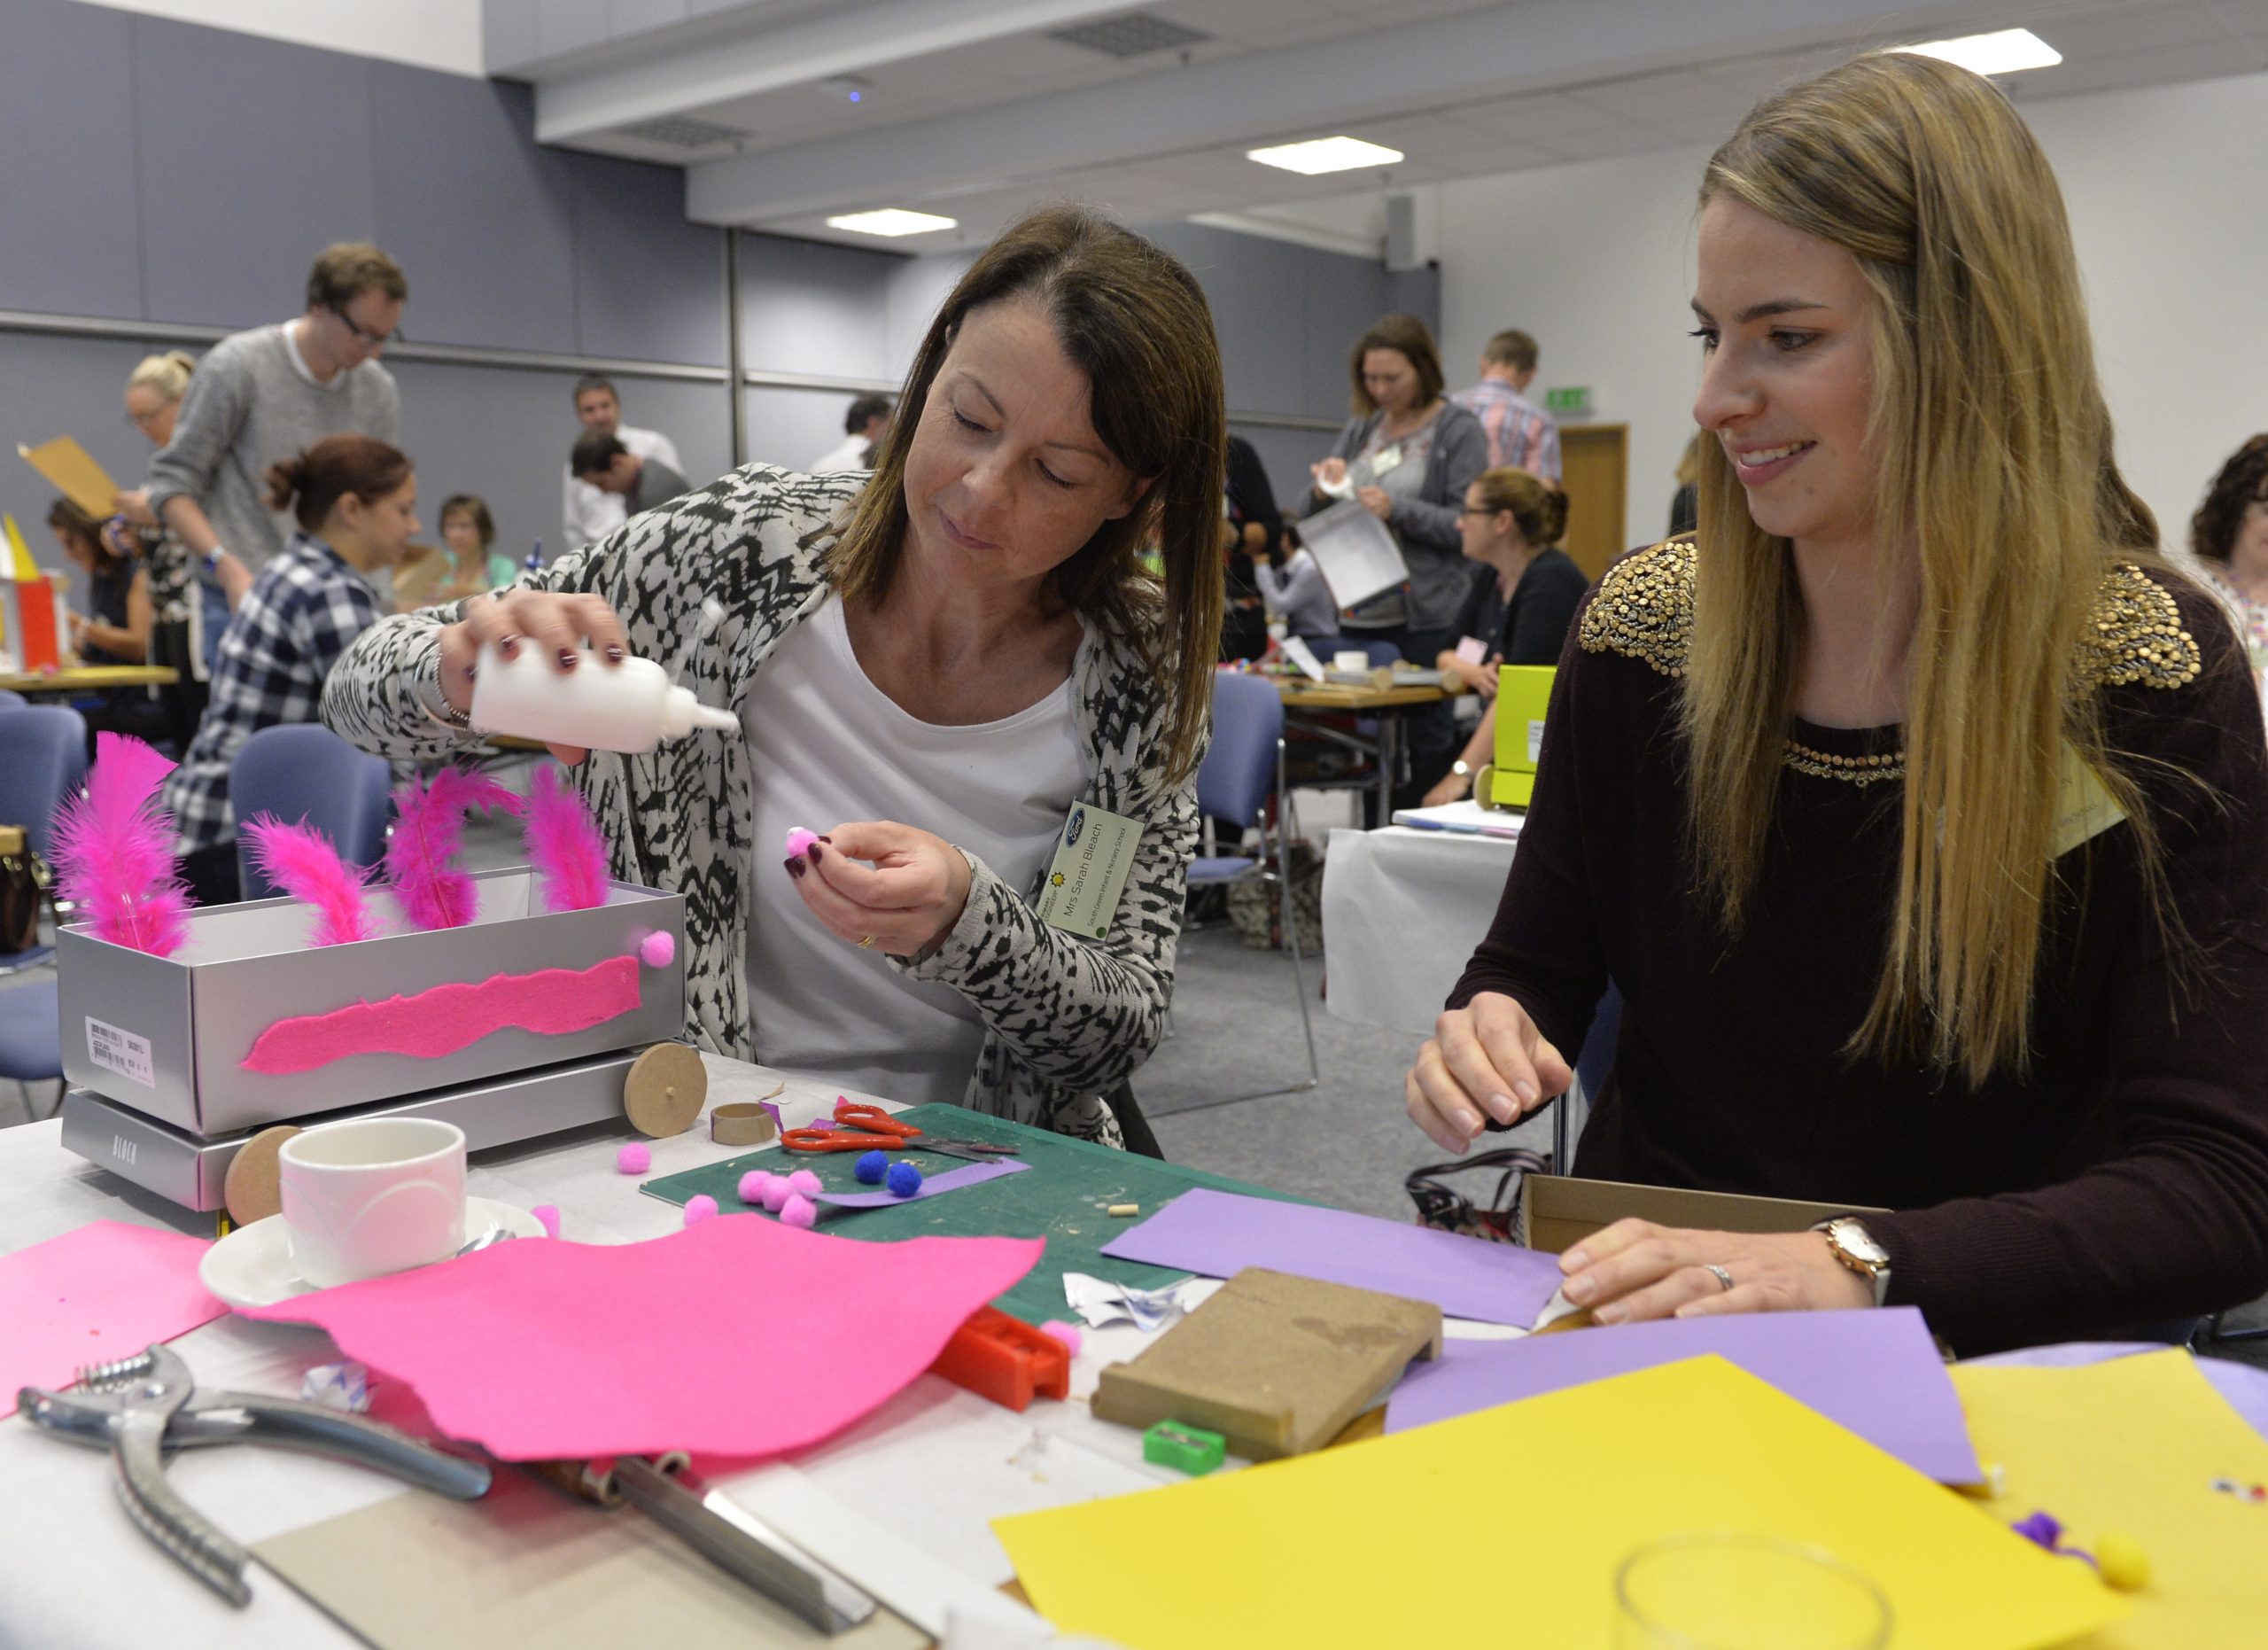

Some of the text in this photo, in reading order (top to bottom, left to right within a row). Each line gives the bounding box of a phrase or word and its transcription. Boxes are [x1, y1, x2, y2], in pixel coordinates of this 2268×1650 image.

[1068, 813, 1084, 842] Ford
[1063, 822, 1103, 917] Mrs Sarah Bleach
[1087, 908, 1098, 927] South
[1094, 892, 1104, 910] Green
[1099, 875, 1109, 892] Infant
[1107, 846, 1121, 869] Nursery
[1115, 827, 1126, 847] School
[113, 1135, 136, 1165] BLOCH
